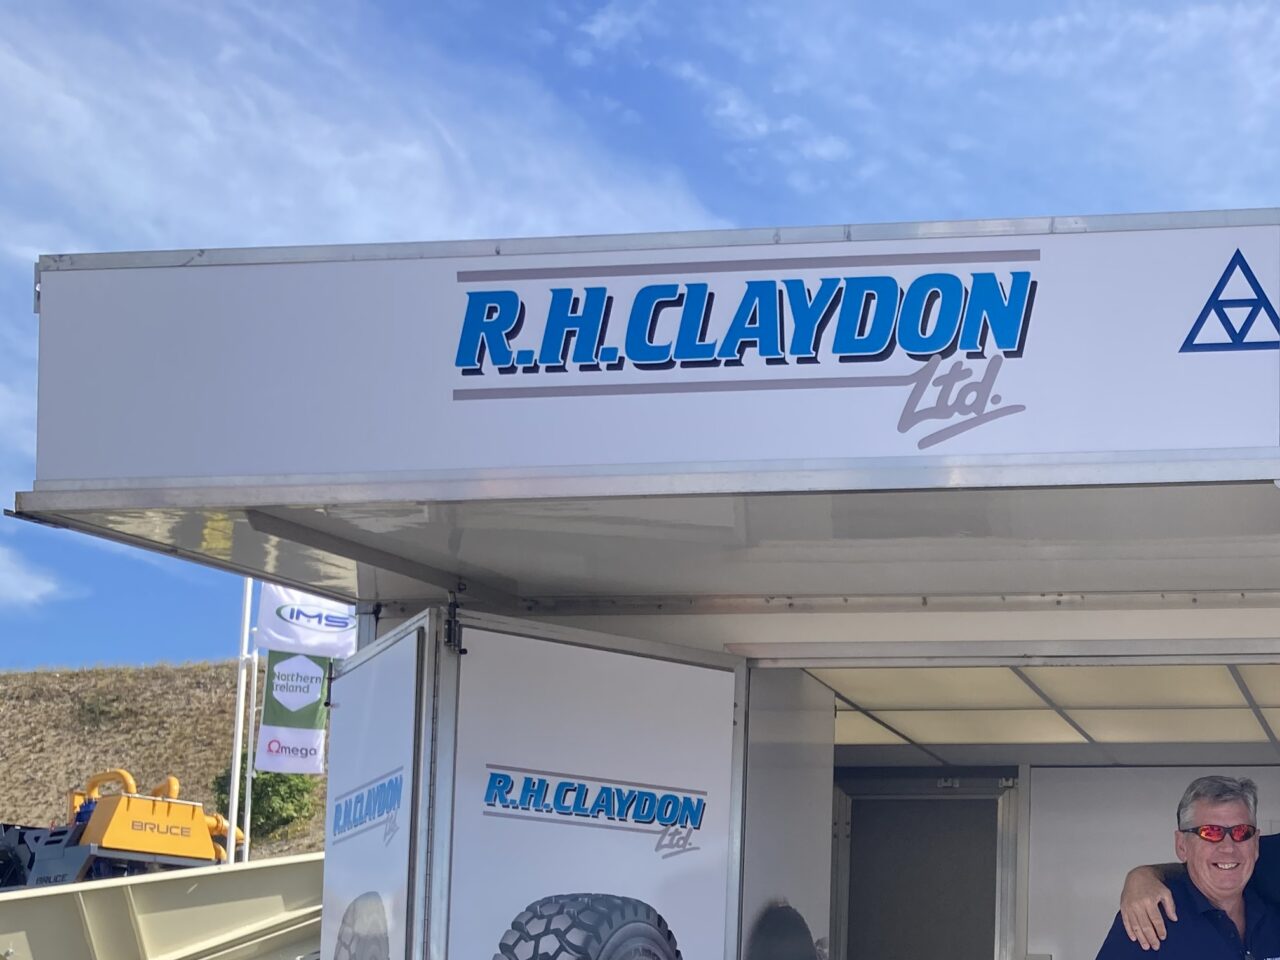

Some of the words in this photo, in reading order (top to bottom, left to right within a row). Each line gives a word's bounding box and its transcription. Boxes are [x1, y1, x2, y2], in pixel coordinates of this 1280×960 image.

[454, 270, 1038, 376] R.H.CLAYDON
[897, 355, 1004, 434] Ltd.
[289, 607, 350, 629] IMS
[483, 771, 707, 830] R.H.CLAYDON
[131, 820, 192, 837] BRUCE
[655, 826, 693, 853] Ltd.
